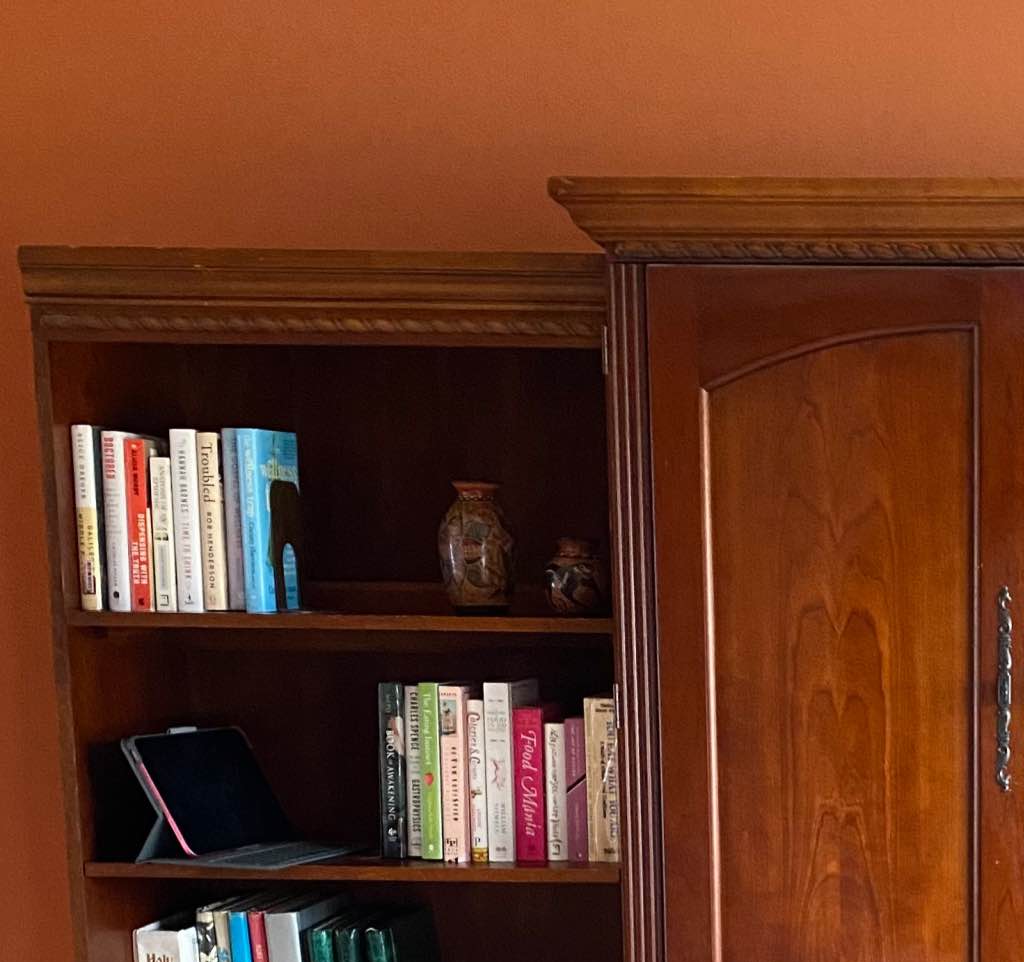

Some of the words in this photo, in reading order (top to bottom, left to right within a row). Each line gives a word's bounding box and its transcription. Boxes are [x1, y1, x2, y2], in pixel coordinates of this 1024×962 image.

[201, 442, 215, 502] Troubled
[138, 513, 147, 561] DISPENSING
[410, 692, 419, 722] CHARLES
[386, 730, 394, 758] BOOK
[411, 725, 419, 750] SPENCE
[520, 730, 538, 771] Food
[387, 766, 395, 821] AWAKENING
[412, 779, 421, 832] GASTROPHYSICS
[521, 776, 542, 836] Mania
